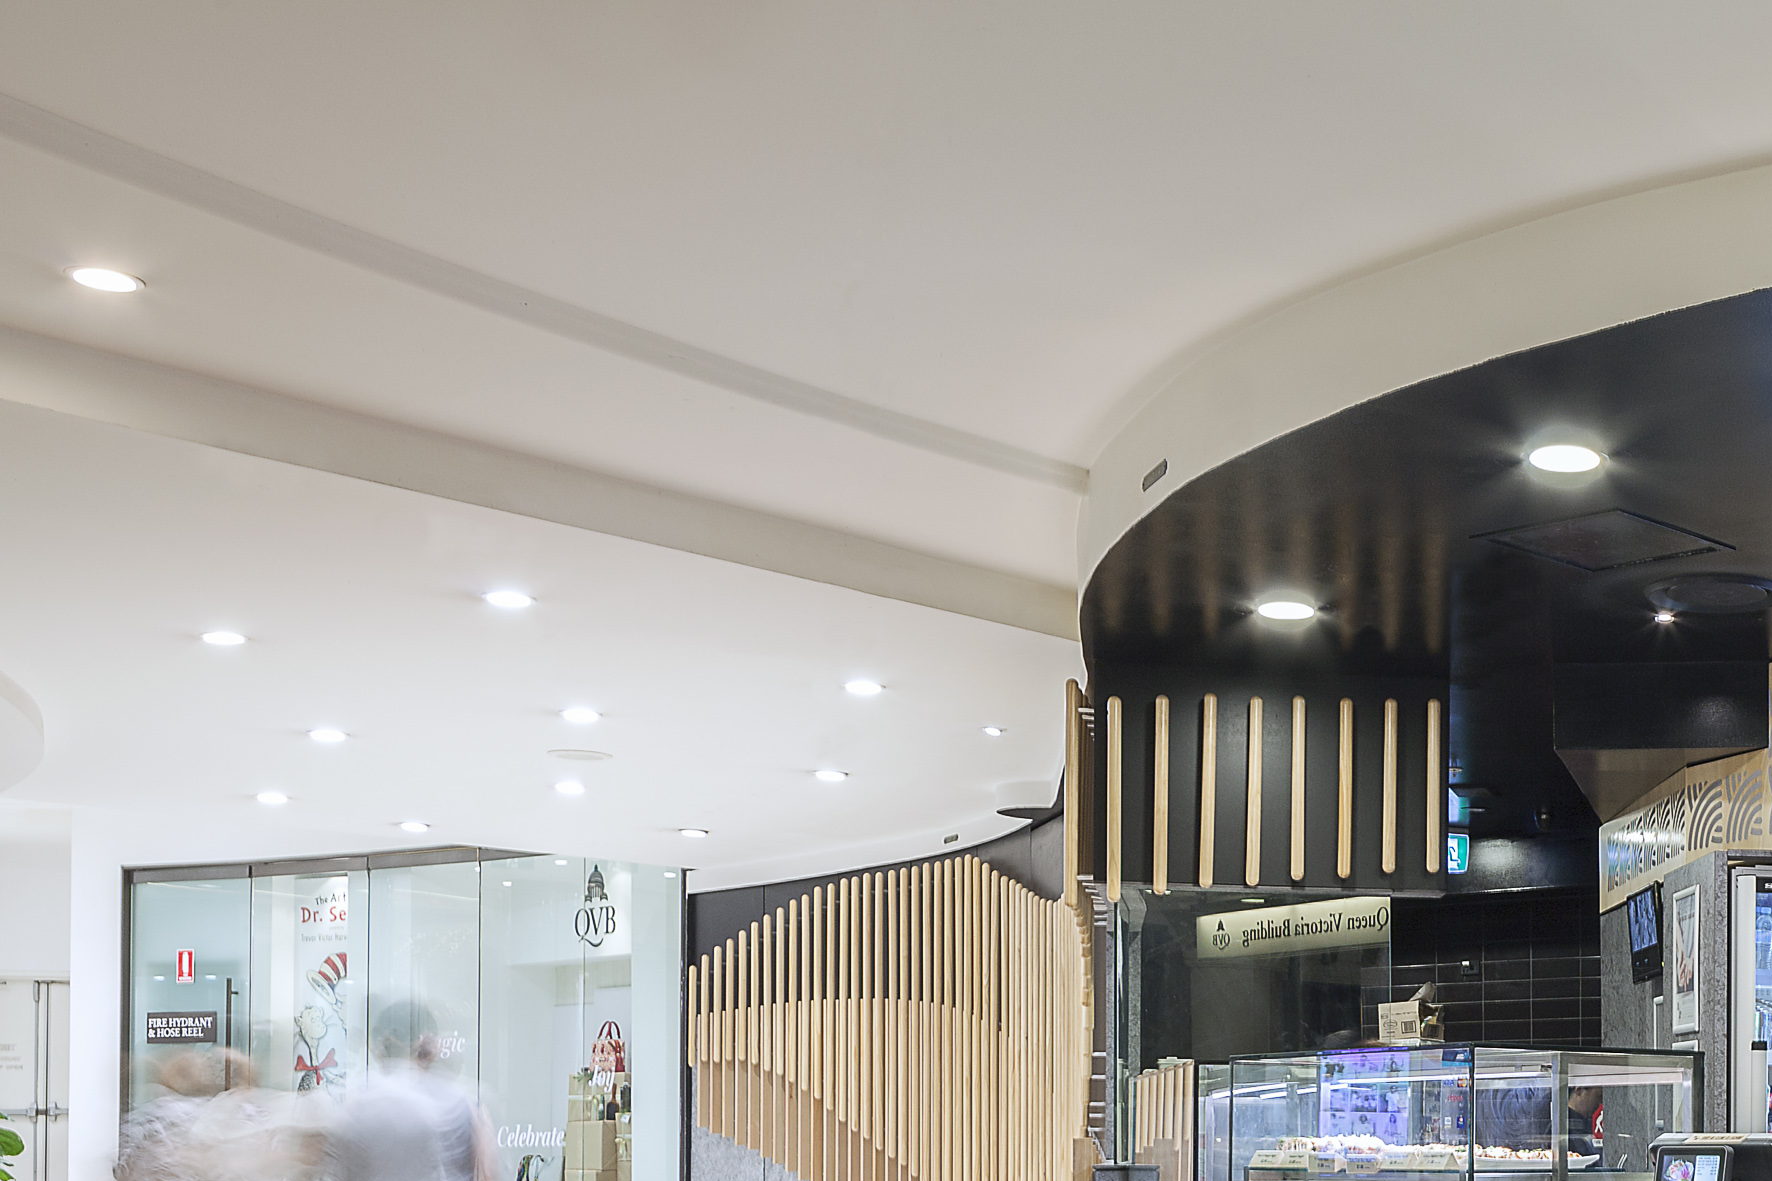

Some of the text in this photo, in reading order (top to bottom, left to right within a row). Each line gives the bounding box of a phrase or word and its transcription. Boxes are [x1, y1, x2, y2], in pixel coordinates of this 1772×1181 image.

[315, 891, 346, 906] The Art
[300, 905, 347, 923] Dr. Se
[574, 905, 616, 947] QVB
[148, 1017, 213, 1028] FIRE HYDRANT
[148, 1027, 204, 1038] & HOSE REEL
[588, 1065, 616, 1092] Joy
[497, 1124, 566, 1148] Celebrate
